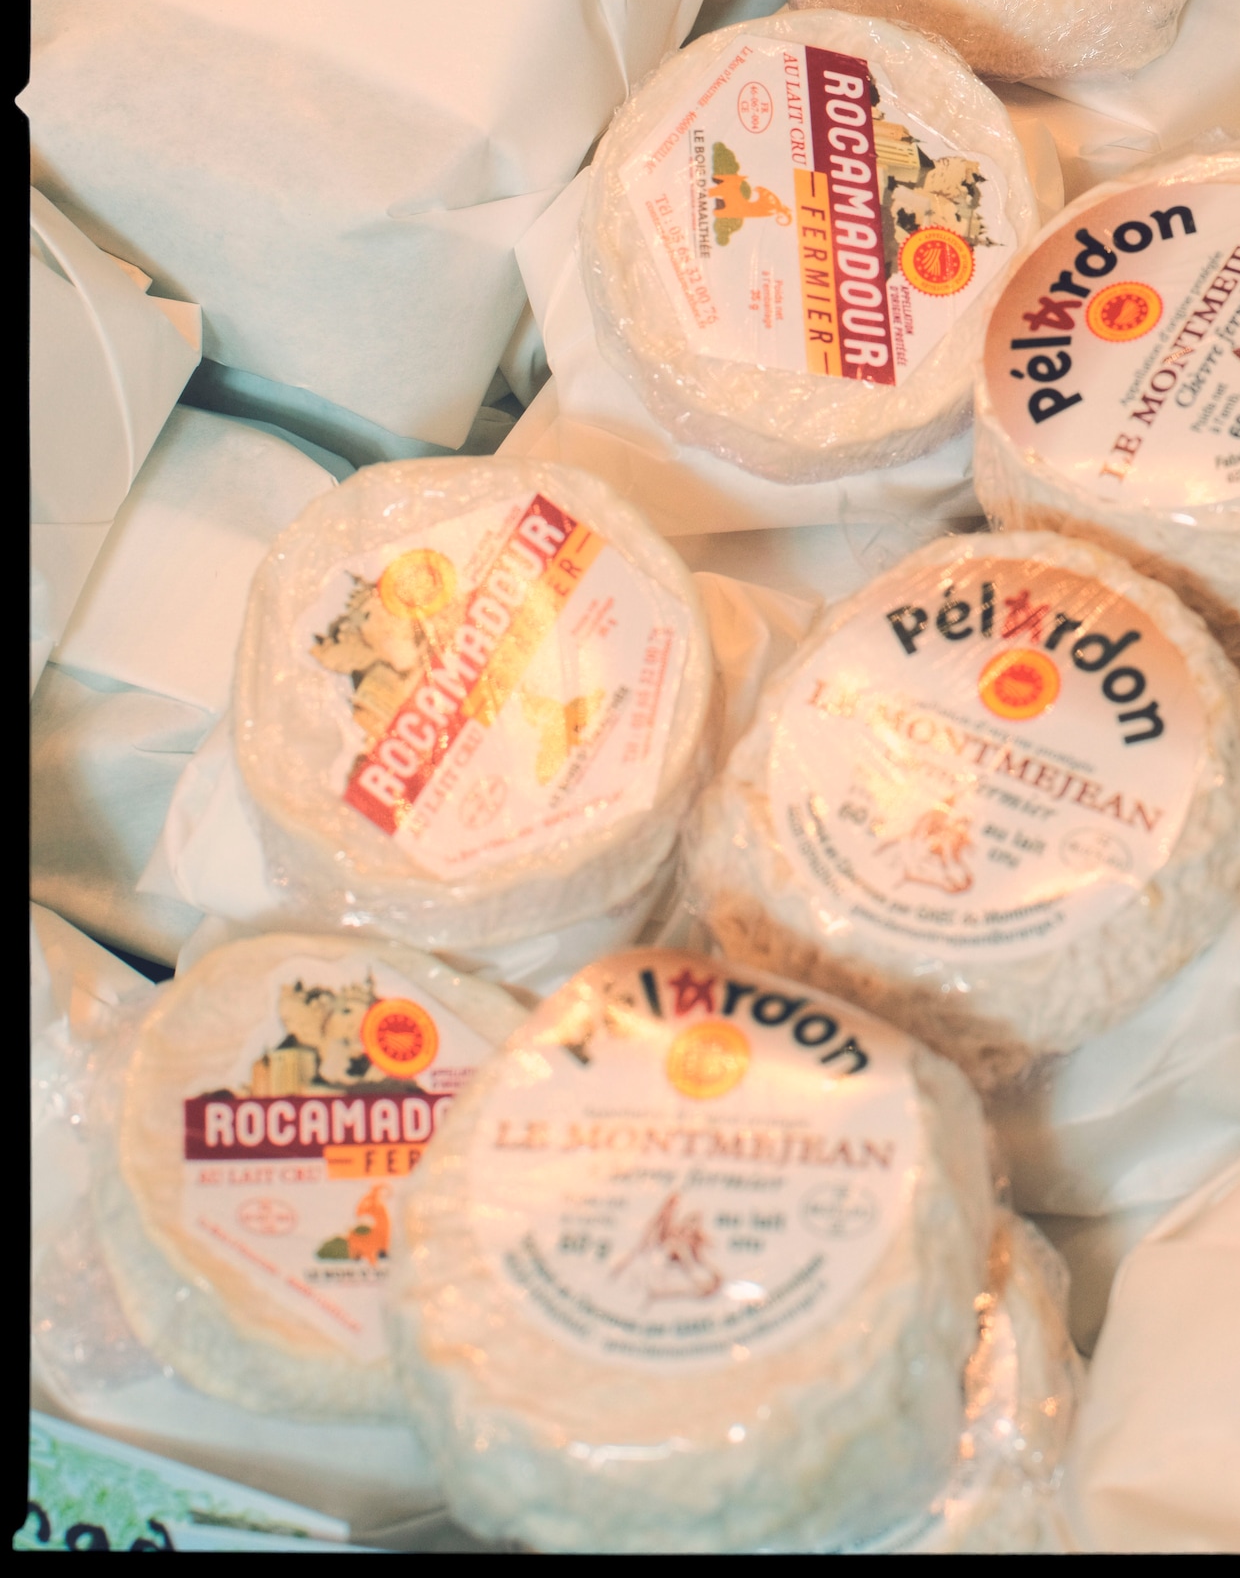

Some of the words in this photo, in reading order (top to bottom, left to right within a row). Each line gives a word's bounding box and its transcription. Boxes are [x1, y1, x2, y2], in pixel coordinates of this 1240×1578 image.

[783, 52, 799, 77] AU
[786, 80, 804, 124] LAIT
[694, 129, 704, 143] LE
[789, 127, 806, 165] CRU
[696, 179, 710, 259] D'AMALTHÉE
[822, 70, 890, 370] ROCAMADOUR
[800, 204, 835, 346] FERMIER
[1100, 433, 1143, 483] LE
[357, 512, 567, 808] ROCAMADOUR
